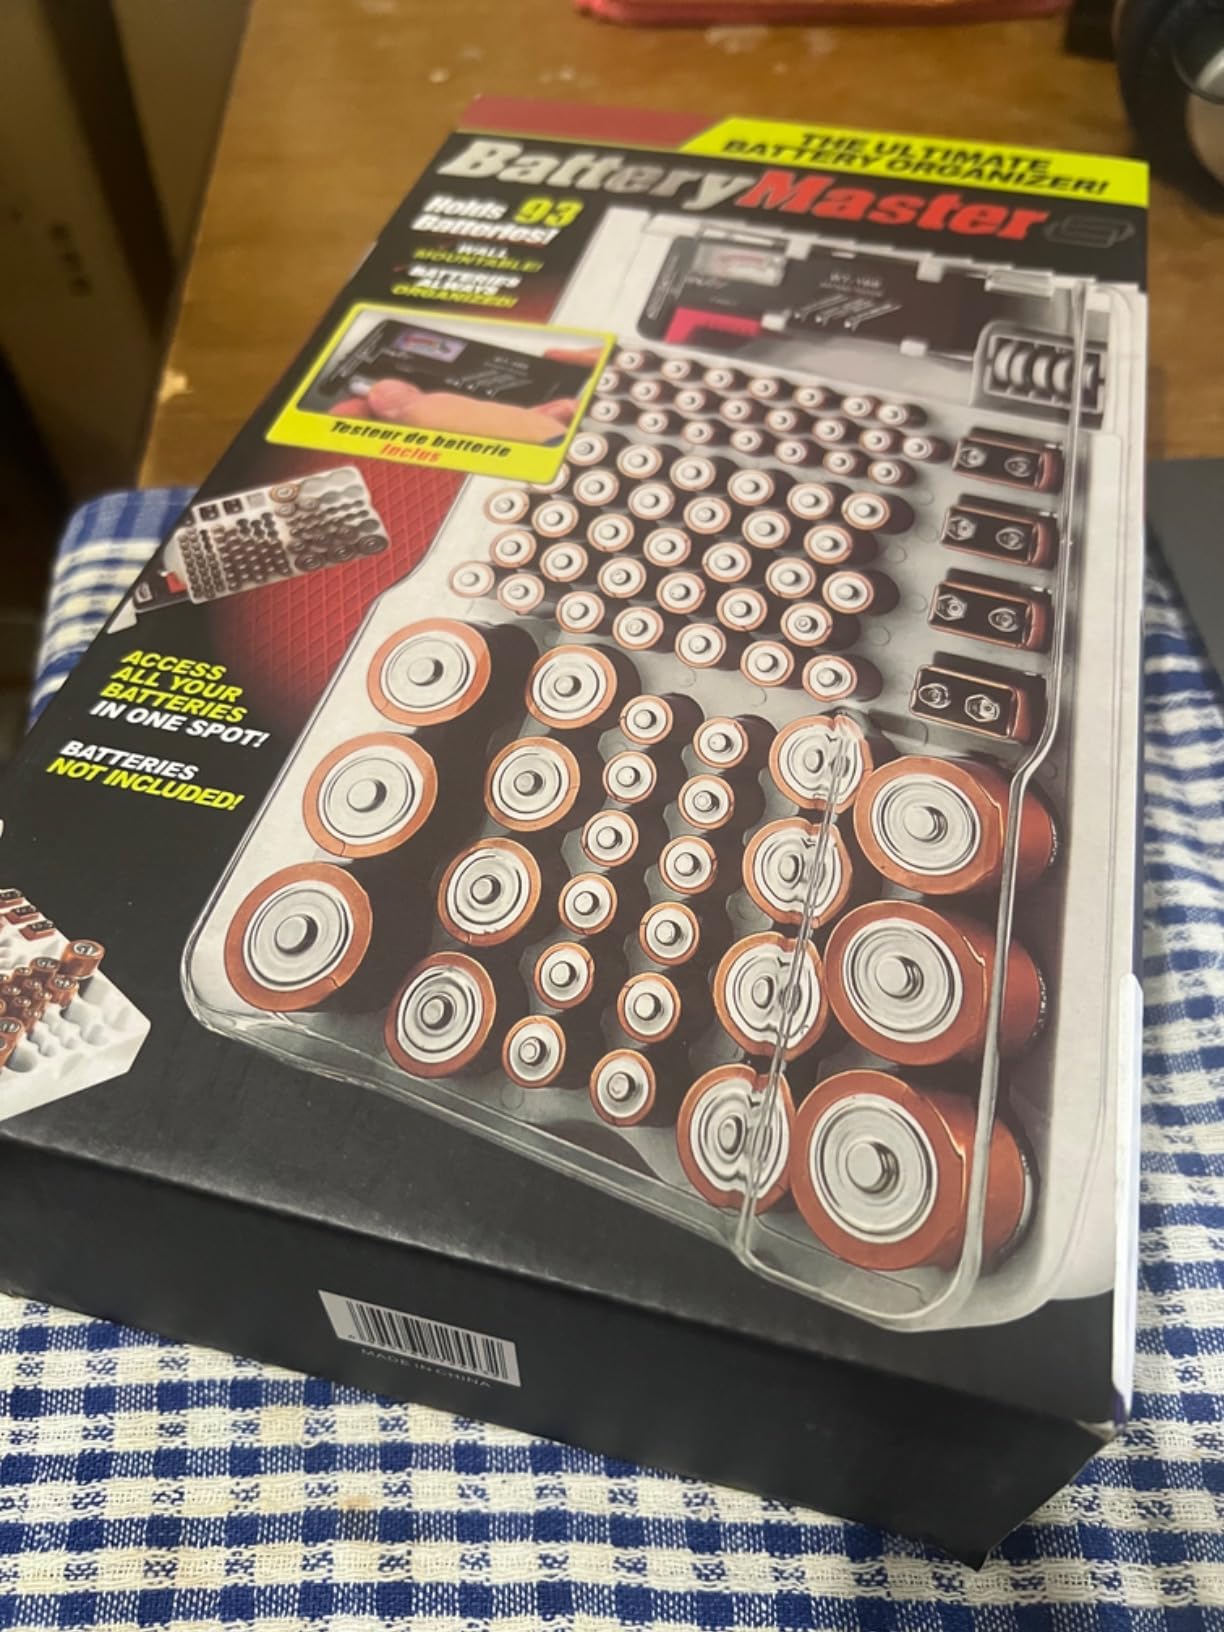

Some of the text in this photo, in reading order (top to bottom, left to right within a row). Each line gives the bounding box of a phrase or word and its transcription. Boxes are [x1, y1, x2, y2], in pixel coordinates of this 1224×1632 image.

[722, 139, 1109, 196] BATTERY ORGANIZER!
[801, 132, 1051, 172] THE ULTIMATE
[411, 213, 561, 245] Batteries!
[424, 195, 584, 228] Holds 93
[408, 265, 523, 288] BATTERIES
[330, 420, 513, 459] Testeur de batterie
[111, 666, 243, 703] ALL YOUR
[120, 650, 228, 682] ACCESS
[100, 681, 248, 724] BATTERIES
[89, 700, 271, 748] IN ONE SPOT!
[59, 740, 199, 781] BATTERIES
[46, 757, 245, 811] NOT INCLUDED!
[360, 1347, 492, 1388] MADE IN CHINA
